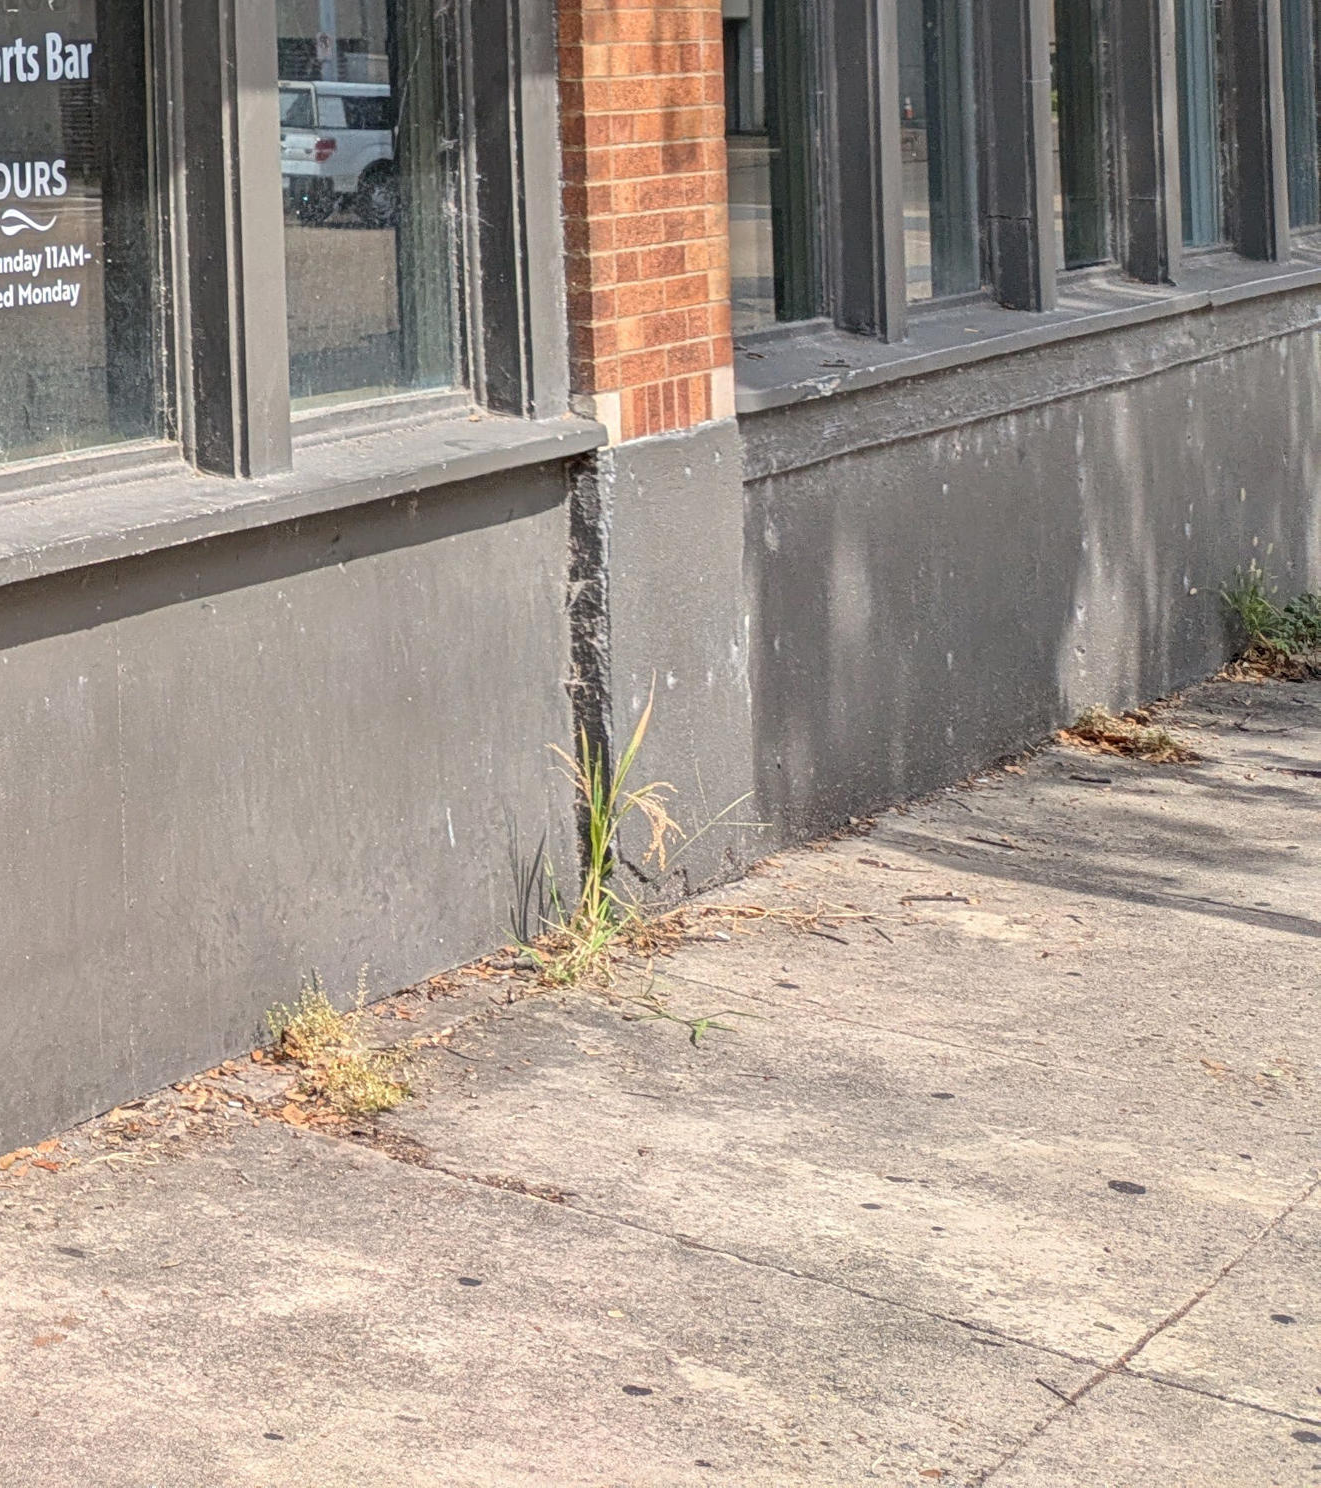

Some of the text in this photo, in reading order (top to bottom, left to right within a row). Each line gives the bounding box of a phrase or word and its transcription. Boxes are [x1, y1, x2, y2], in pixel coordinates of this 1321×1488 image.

[46, 32, 93, 82] Bar
[45, 246, 92, 272] 11AM-
[18, 280, 80, 308] Monday
